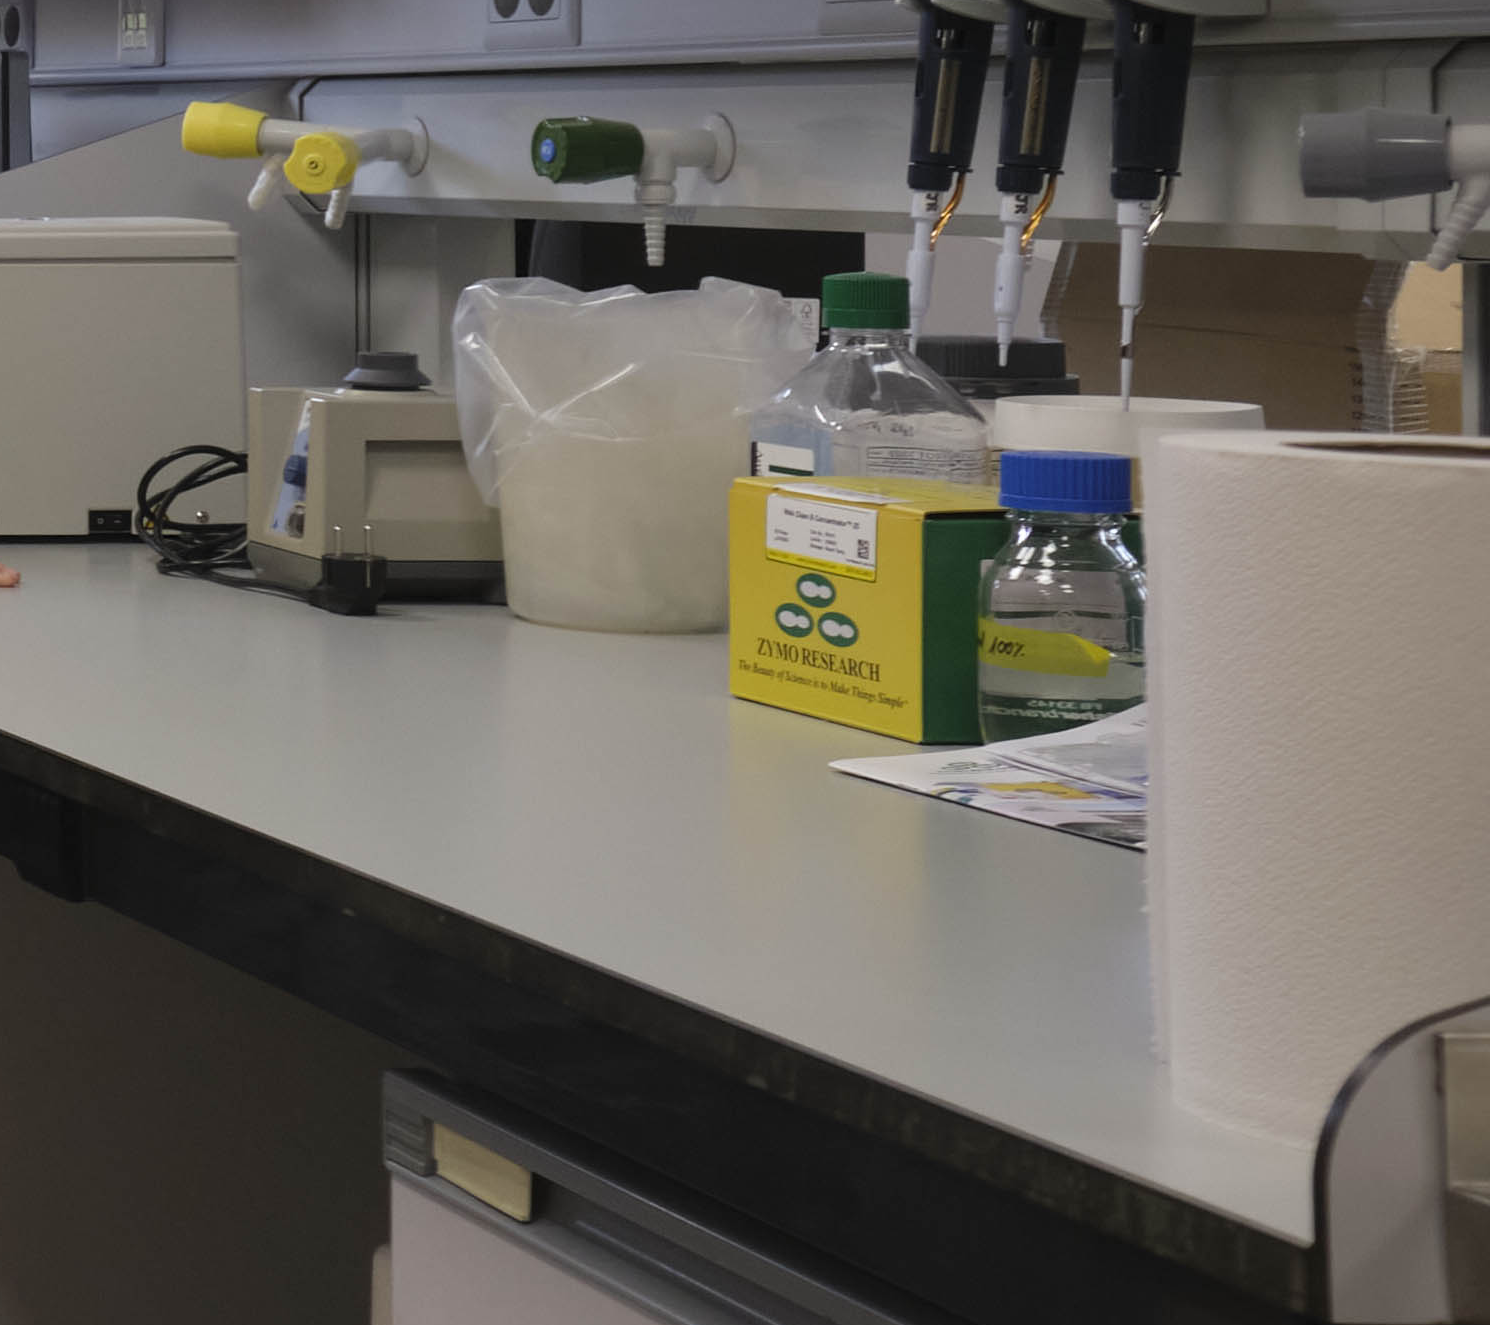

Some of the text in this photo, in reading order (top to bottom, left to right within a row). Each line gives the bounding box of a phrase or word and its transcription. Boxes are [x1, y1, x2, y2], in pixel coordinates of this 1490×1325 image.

[739, 659, 751, 671] The
[752, 662, 776, 678] Beauty
[776, 668, 786, 681] of
[785, 670, 812, 687] Science
[820, 680, 829, 691] to
[829, 680, 851, 695] Make
[851, 686, 877, 704] Things
[757, 637, 882, 683] ZYMO RESEARCH
